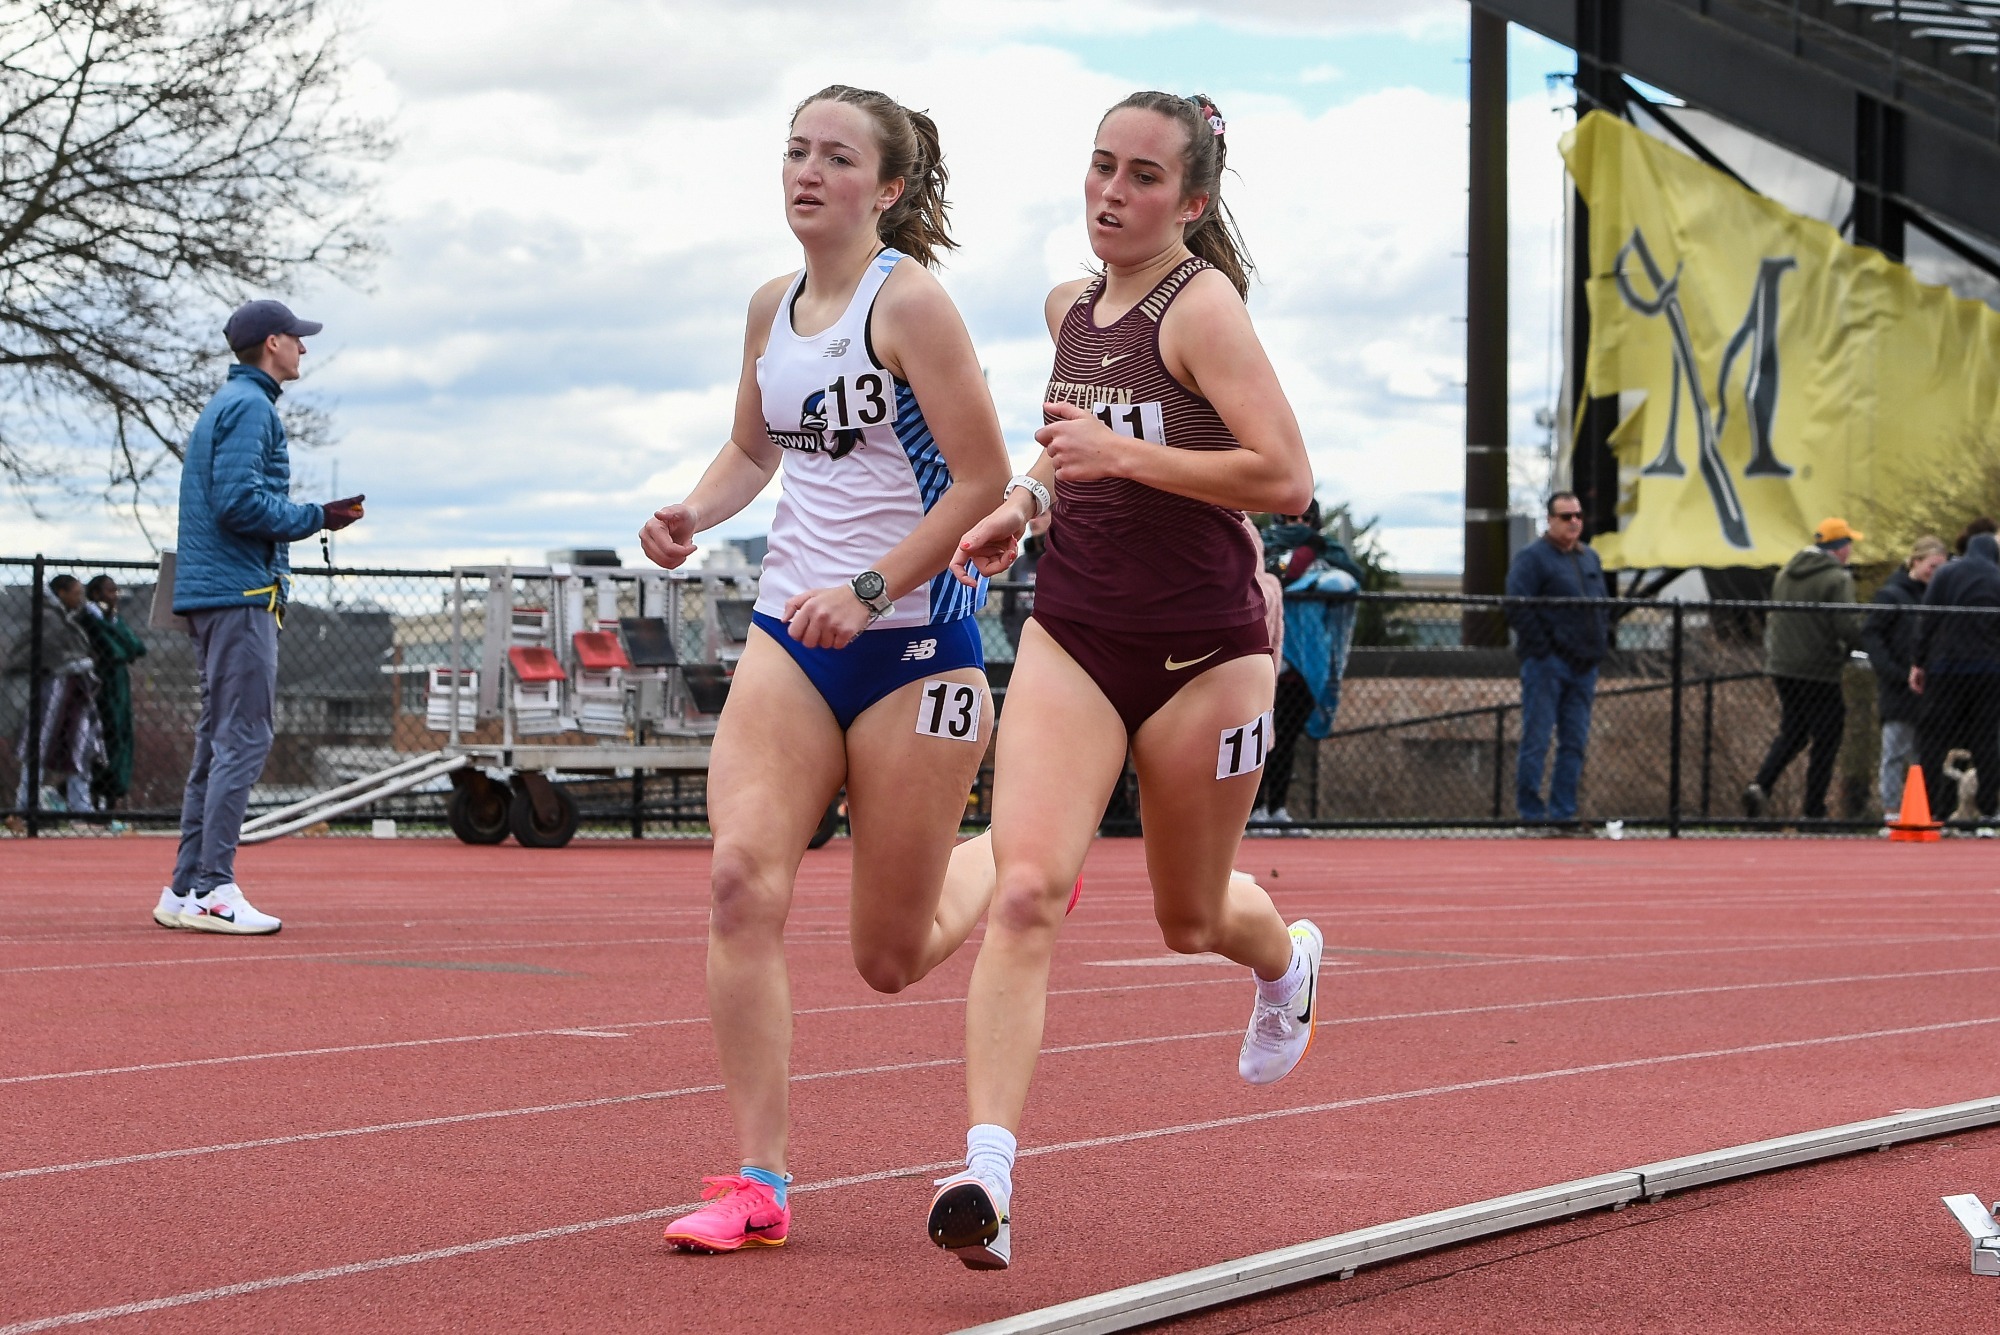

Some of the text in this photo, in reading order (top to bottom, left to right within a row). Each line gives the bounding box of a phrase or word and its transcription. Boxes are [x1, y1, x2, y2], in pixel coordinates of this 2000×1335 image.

[828, 373, 887, 427] 13
[927, 683, 974, 738] 13
[1224, 715, 1263, 774] 11
